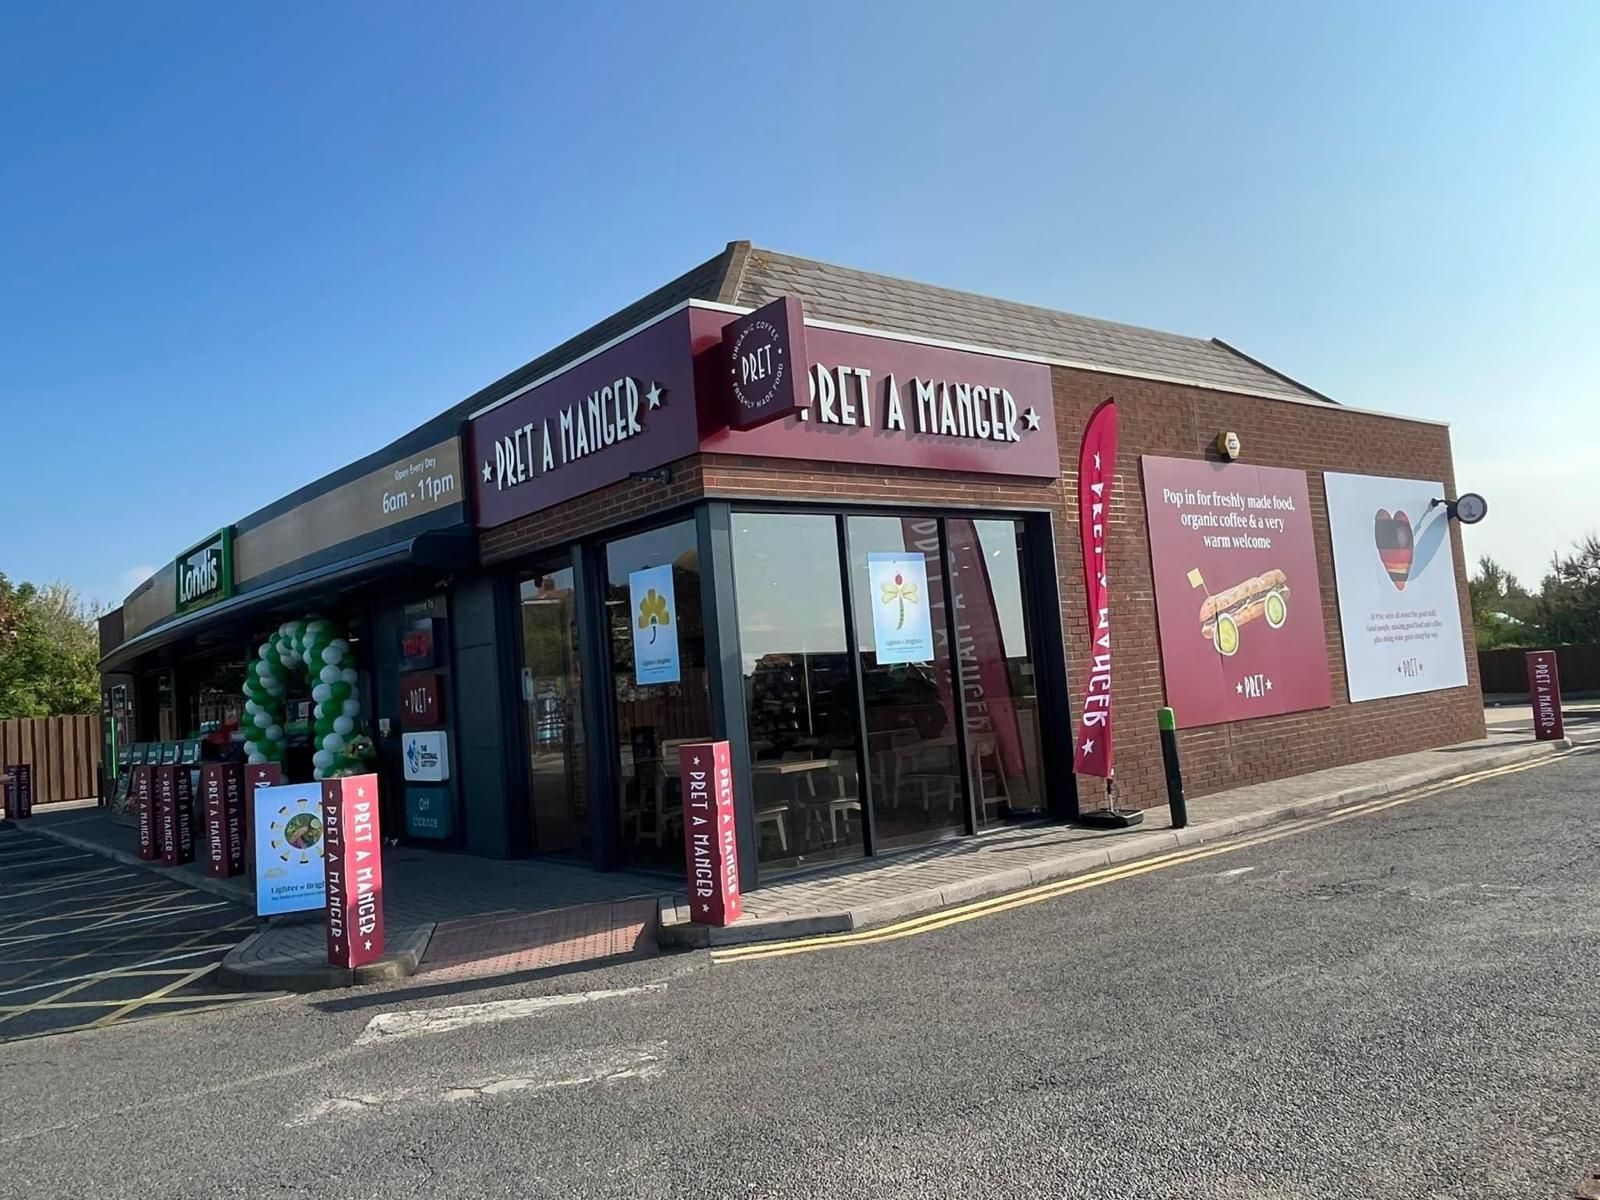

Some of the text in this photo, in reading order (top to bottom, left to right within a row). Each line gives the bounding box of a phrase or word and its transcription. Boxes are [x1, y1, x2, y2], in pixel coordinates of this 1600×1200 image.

[756, 321, 779, 341] COFFEE
[742, 344, 771, 385] PRET
[756, 390, 775, 407] MADE
[772, 363, 784, 390] FOOD
[887, 372, 905, 431] A
[915, 376, 1020, 441] MANGER
[495, 376, 641, 490] PRET A MANGER
[424, 456, 437, 469] Day
[382, 491, 408, 513] 6am
[418, 474, 454, 502] 11pm
[1163, 488, 1295, 511] Pop in for freshly made food,
[1181, 511, 1285, 533] organic coffee & a very
[1203, 533, 1271, 549] warm welcome
[180, 549, 217, 602] Londis
[1402, 658, 1418, 678] PRET
[1535, 664, 1551, 684] PRET
[410, 688, 426, 713] PRET
[1244, 675, 1265, 698] PRET
[1538, 695, 1555, 727] MANGER
[140, 780, 148, 800] PRET
[162, 781, 171, 802] PRET
[208, 781, 219, 805] PRET
[210, 821, 222, 861] MANGER
[690, 771, 713, 897] PRET A MANGER
[719, 768, 737, 895] PRET A MANGER
[327, 805, 342, 937] PRET A MANGER
[353, 802, 376, 937] PRET A MANGER
